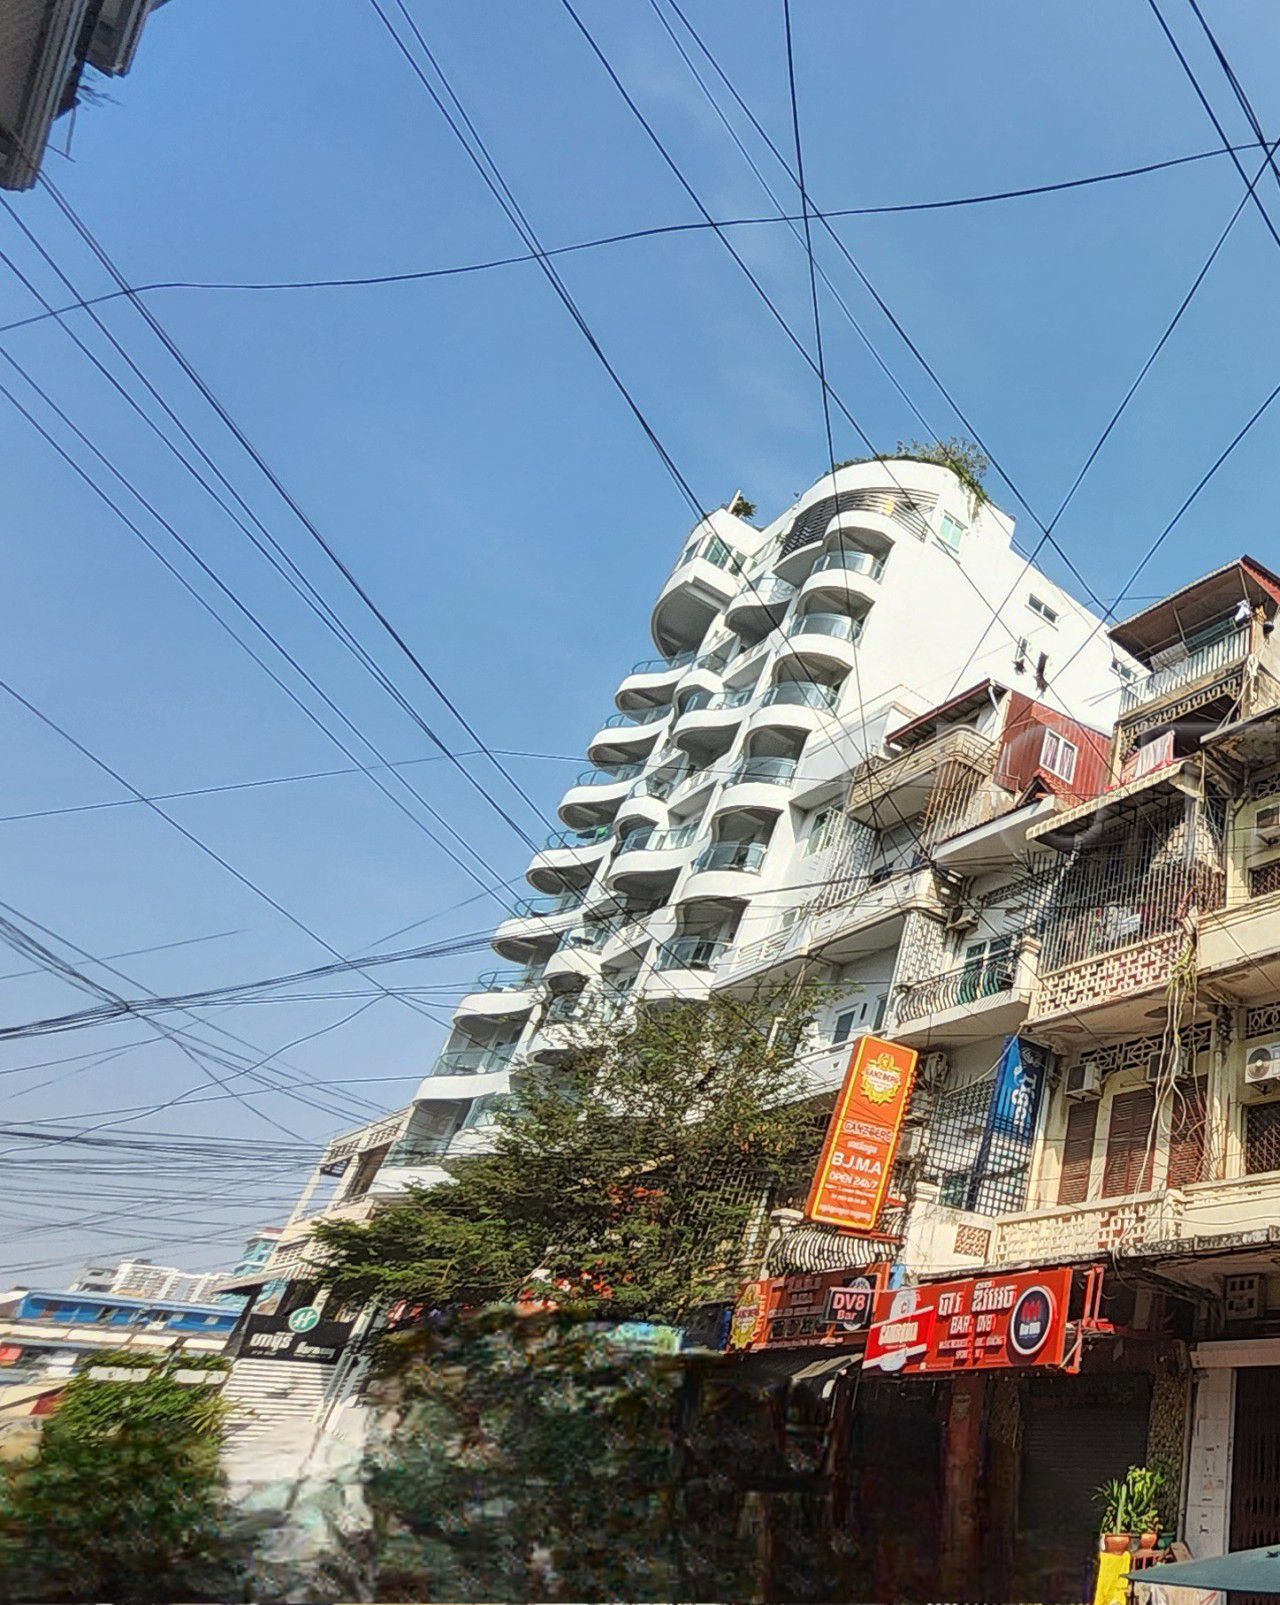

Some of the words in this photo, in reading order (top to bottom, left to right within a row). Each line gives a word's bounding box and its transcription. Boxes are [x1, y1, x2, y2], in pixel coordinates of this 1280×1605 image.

[844, 1120, 894, 1143] GANZBERG
[832, 1292, 866, 1312] DV8
[836, 1309, 858, 1321] Bar
